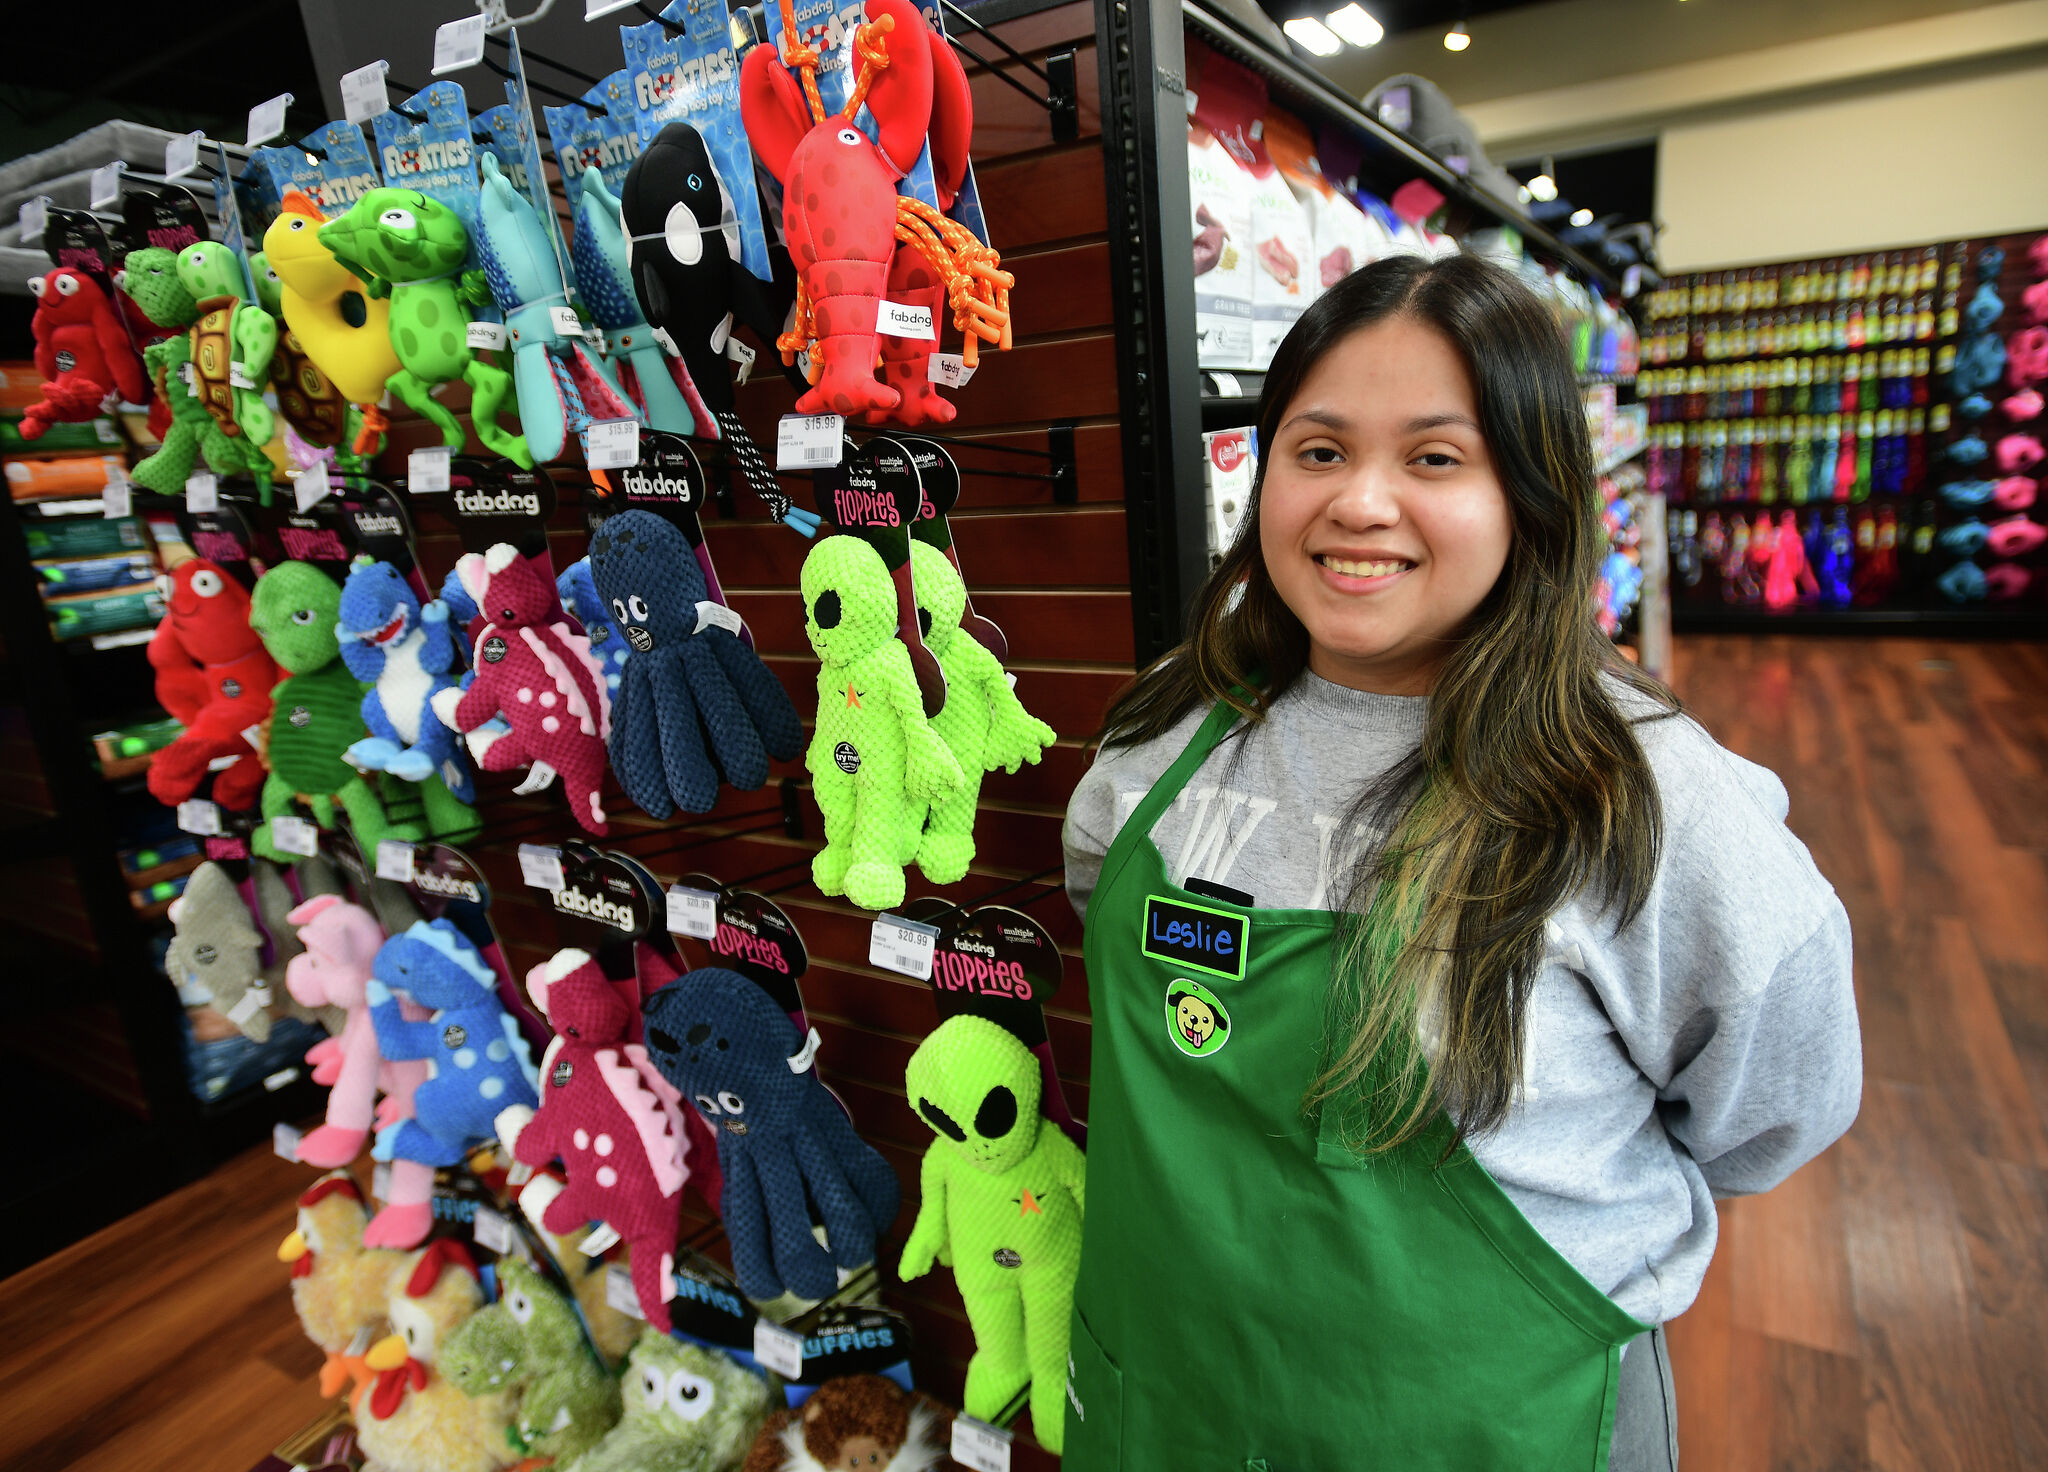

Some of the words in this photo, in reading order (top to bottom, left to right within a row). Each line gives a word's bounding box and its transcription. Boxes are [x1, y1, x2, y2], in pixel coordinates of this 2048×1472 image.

[647, 52, 678, 71] fabdog
[890, 309, 932, 327] fabdog
[608, 423, 633, 436] $15.99
[804, 416, 836, 431] $15.99
[622, 469, 691, 502] fabdog
[849, 476, 877, 491] fabdog
[454, 489, 540, 516] fabdog
[723, 912, 758, 934] fabdog
[897, 929, 928, 947] $20.99
[1153, 911, 1234, 955] Leslie
[953, 937, 996, 958] fabdog
